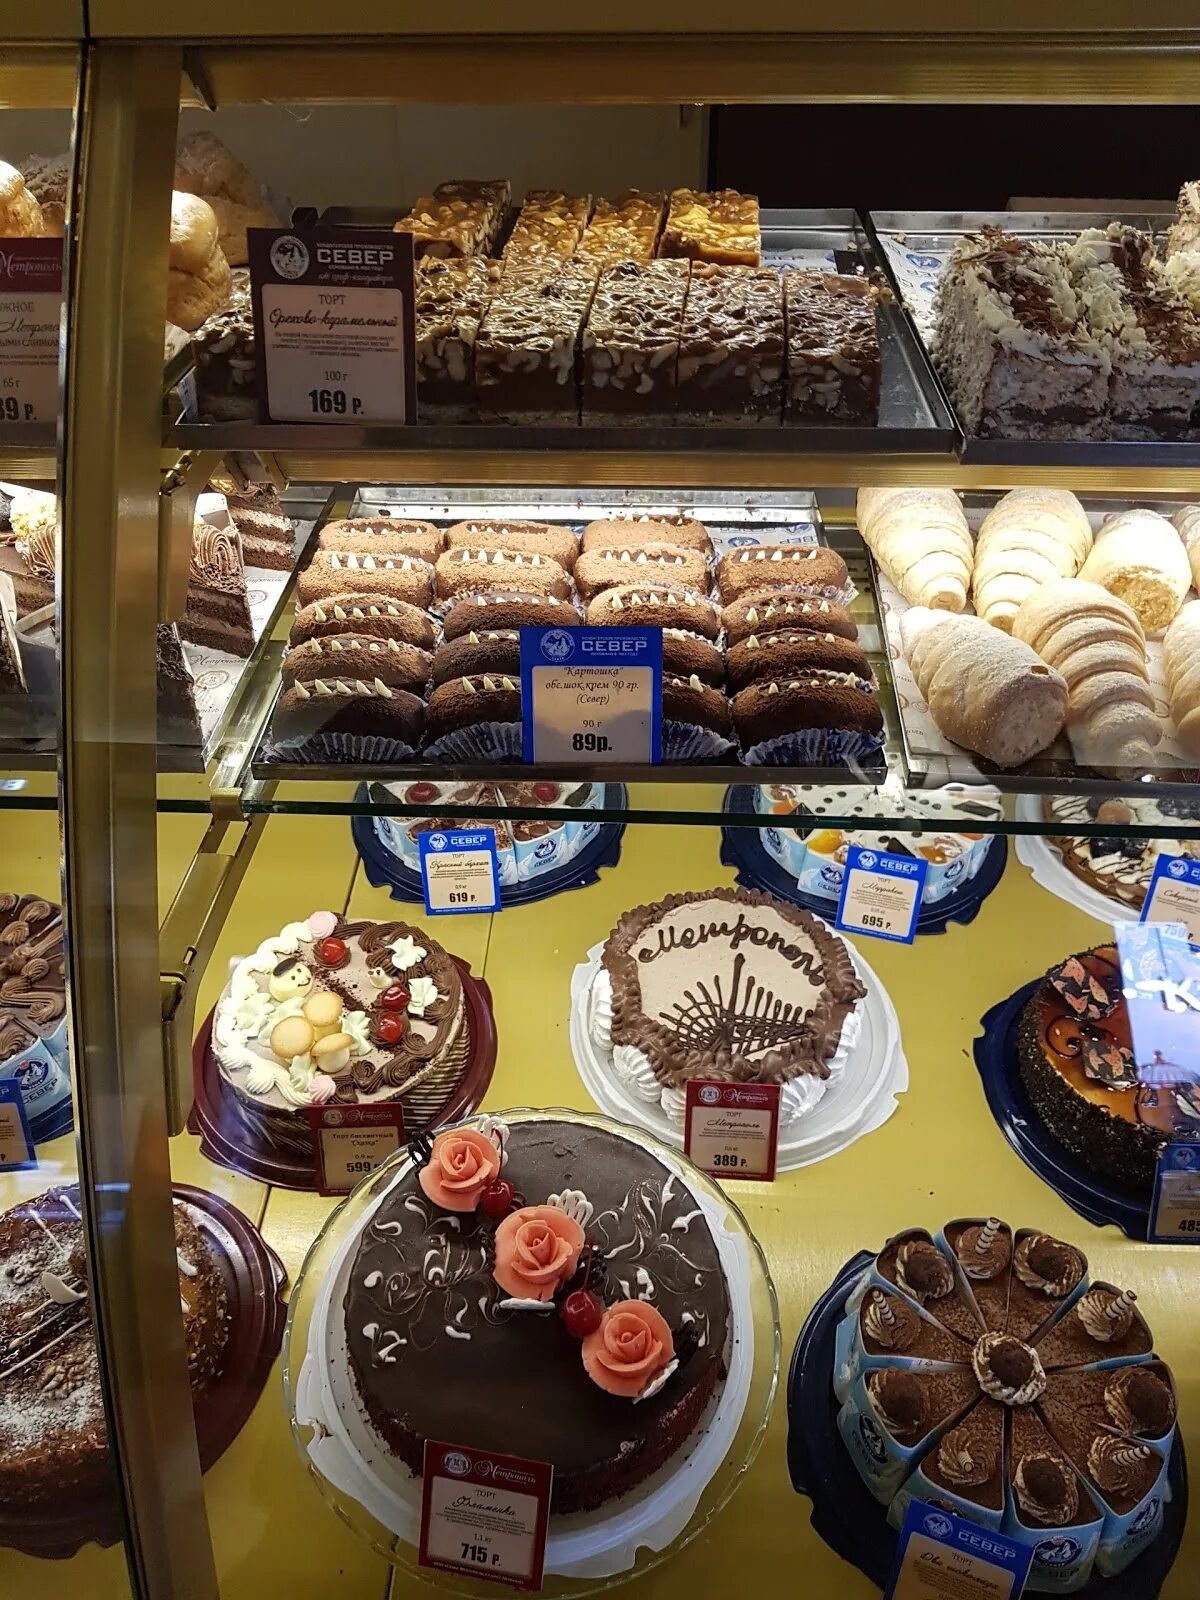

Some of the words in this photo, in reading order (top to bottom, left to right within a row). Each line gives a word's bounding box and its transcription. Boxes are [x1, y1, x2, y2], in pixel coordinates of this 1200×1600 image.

[317, 249, 394, 265] СЕВЕР
[318, 294, 346, 305] ТОРТ
[0, 302, 34, 312] ЖНОЕ
[325, 371, 341, 381] 100
[343, 373, 348, 381] г
[3, 378, 14, 388] 65
[308, 389, 346, 414] 169
[581, 641, 648, 652] СЕВЕР
[563, 667, 624, 678] "Картошка"
[612, 680, 625, 690] 90
[626, 684, 639, 692] гр.
[576, 694, 610, 705] (Север)
[582, 720, 594, 728] 90
[572, 733, 613, 752] 89р.
[451, 836, 487, 845] СЕВЕР
[880, 860, 918, 873] СЕВЕР
[449, 892, 468, 903] 619
[862, 914, 884, 928] 695
[638, 913, 825, 986] Метрополь
[713, 1154, 738, 1167] 389
[346, 1162, 371, 1173] 599
[474, 1460, 536, 1484] Метрополь
[475, 1489, 497, 1500] ТОРТ
[451, 1496, 516, 1516] Фламенко
[957, 1531, 1017, 1559] СЕВЕР
[461, 1542, 488, 1563] 715
[952, 1553, 974, 1567] ТОРТ
